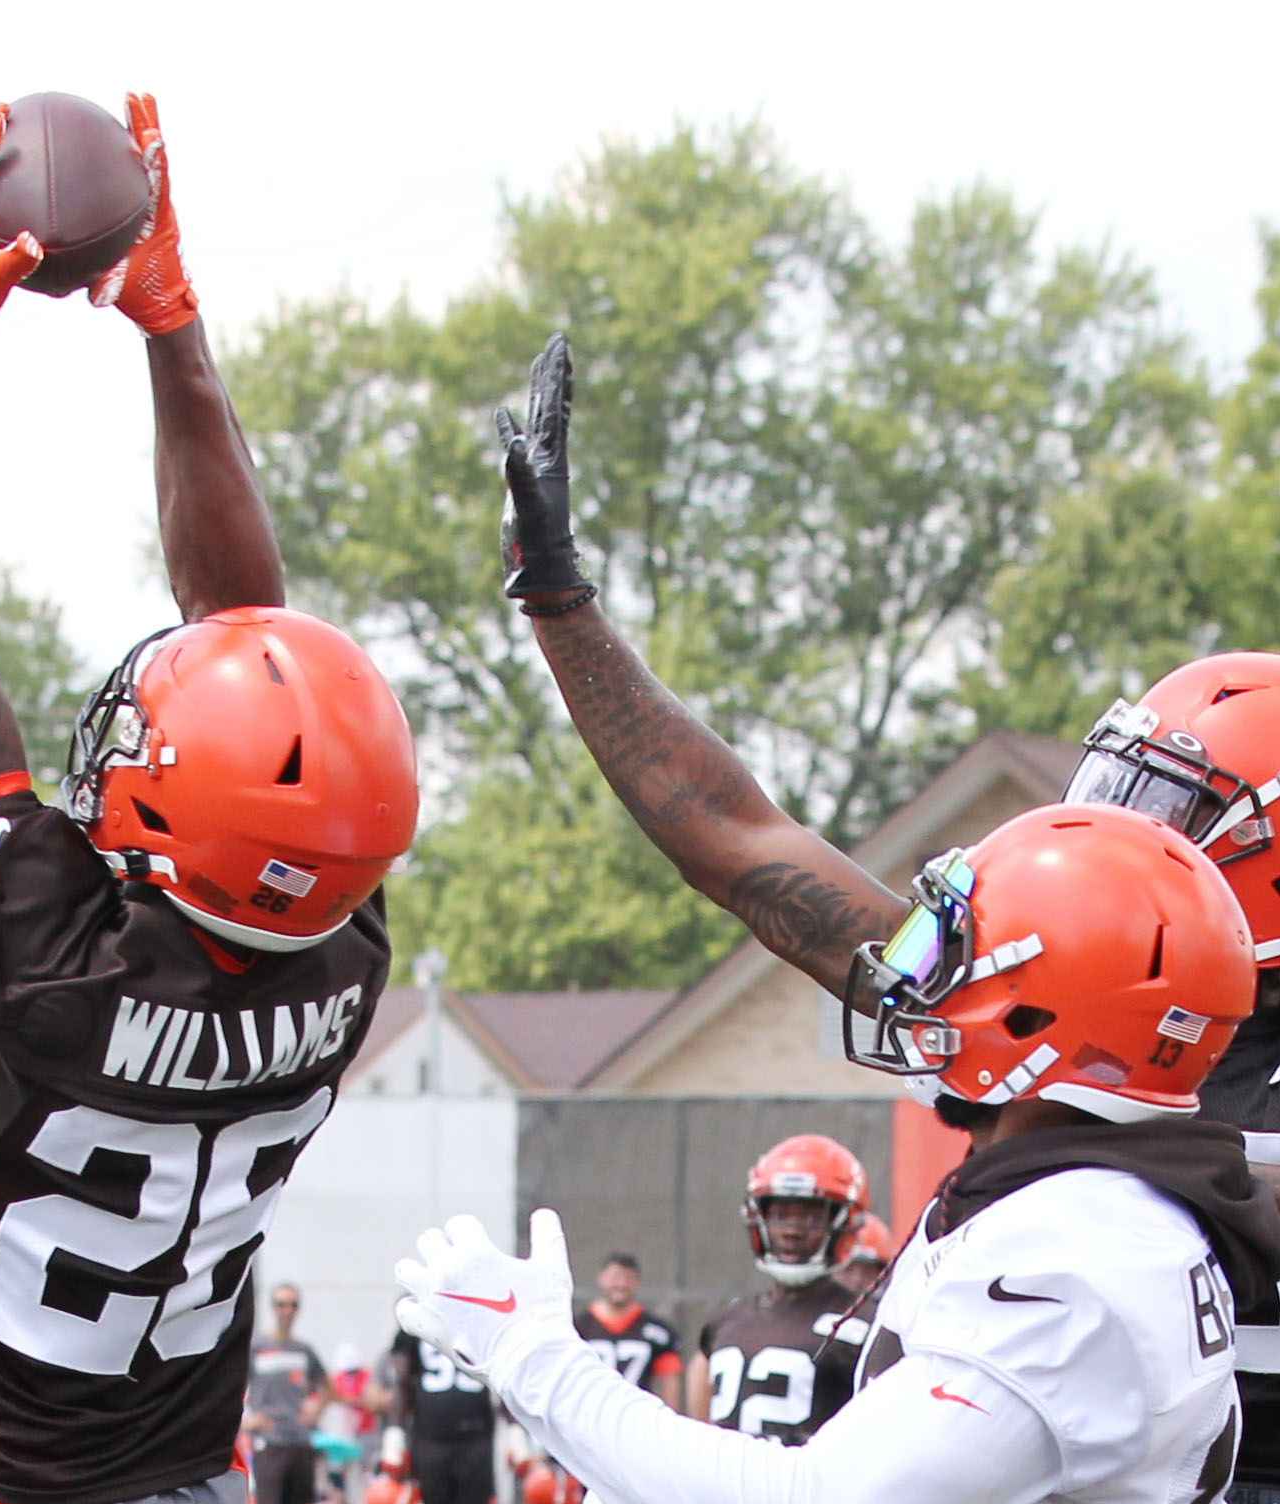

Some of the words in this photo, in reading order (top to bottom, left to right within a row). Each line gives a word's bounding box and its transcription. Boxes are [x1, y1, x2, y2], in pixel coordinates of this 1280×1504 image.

[250, 885, 293, 914] 26
[102, 983, 363, 1091] WILLIAMS
[1148, 1038, 1184, 1068] 13
